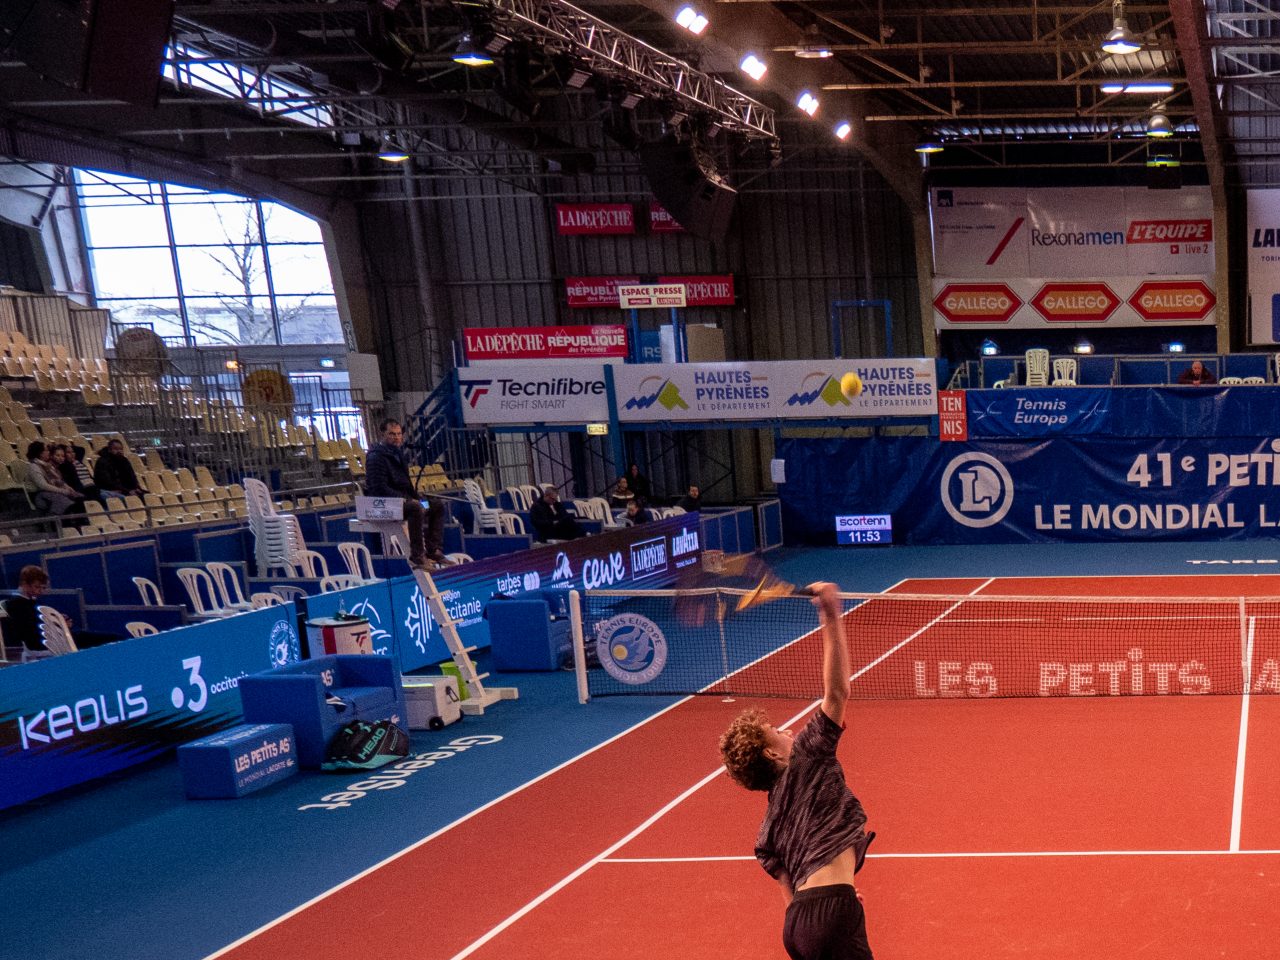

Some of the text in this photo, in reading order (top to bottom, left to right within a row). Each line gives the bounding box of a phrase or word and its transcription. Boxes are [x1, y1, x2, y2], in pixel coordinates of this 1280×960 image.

[558, 210, 575, 226] LA
[576, 208, 632, 226] DÉPÊCHE
[1132, 223, 1209, 240] L'EQUIPE
[621, 287, 682, 296] ESPACE PRESSE
[945, 297, 1009, 310] GALLEGO
[1043, 296, 1108, 309] GALLEGO
[1141, 294, 1206, 308] GALLEGO
[467, 333, 545, 352] LA DÉPÊCHE
[497, 378, 606, 397] Tecnifibre
[696, 384, 769, 400] PYRÉNÉES
[501, 399, 567, 410] FIGHT SMART
[697, 402, 771, 411] LE DÉPARTEMENT
[860, 398, 933, 407] LE DÉPARTEMENT
[941, 397, 962, 412] TEN
[1016, 398, 1066, 410] Tennis
[1014, 412, 1068, 426] Europe
[943, 420, 963, 435] NIS
[839, 516, 886, 526] scortenn
[1034, 504, 1072, 530] LE
[1081, 503, 1244, 529] MONDIAL
[672, 527, 699, 557] LAVAZZA
[848, 531, 881, 542] 11:53
[583, 551, 625, 590] cewe
[497, 572, 522, 592] tarbes
[600, 617, 626, 645] TENNIS
[629, 616, 662, 647] EUROPE
[604, 657, 638, 682] JUNIOR
[914, 660, 998, 697] LES
[358, 727, 386, 760] HEAD
[234, 753, 250, 773] LES
[279, 737, 290, 754] AS
